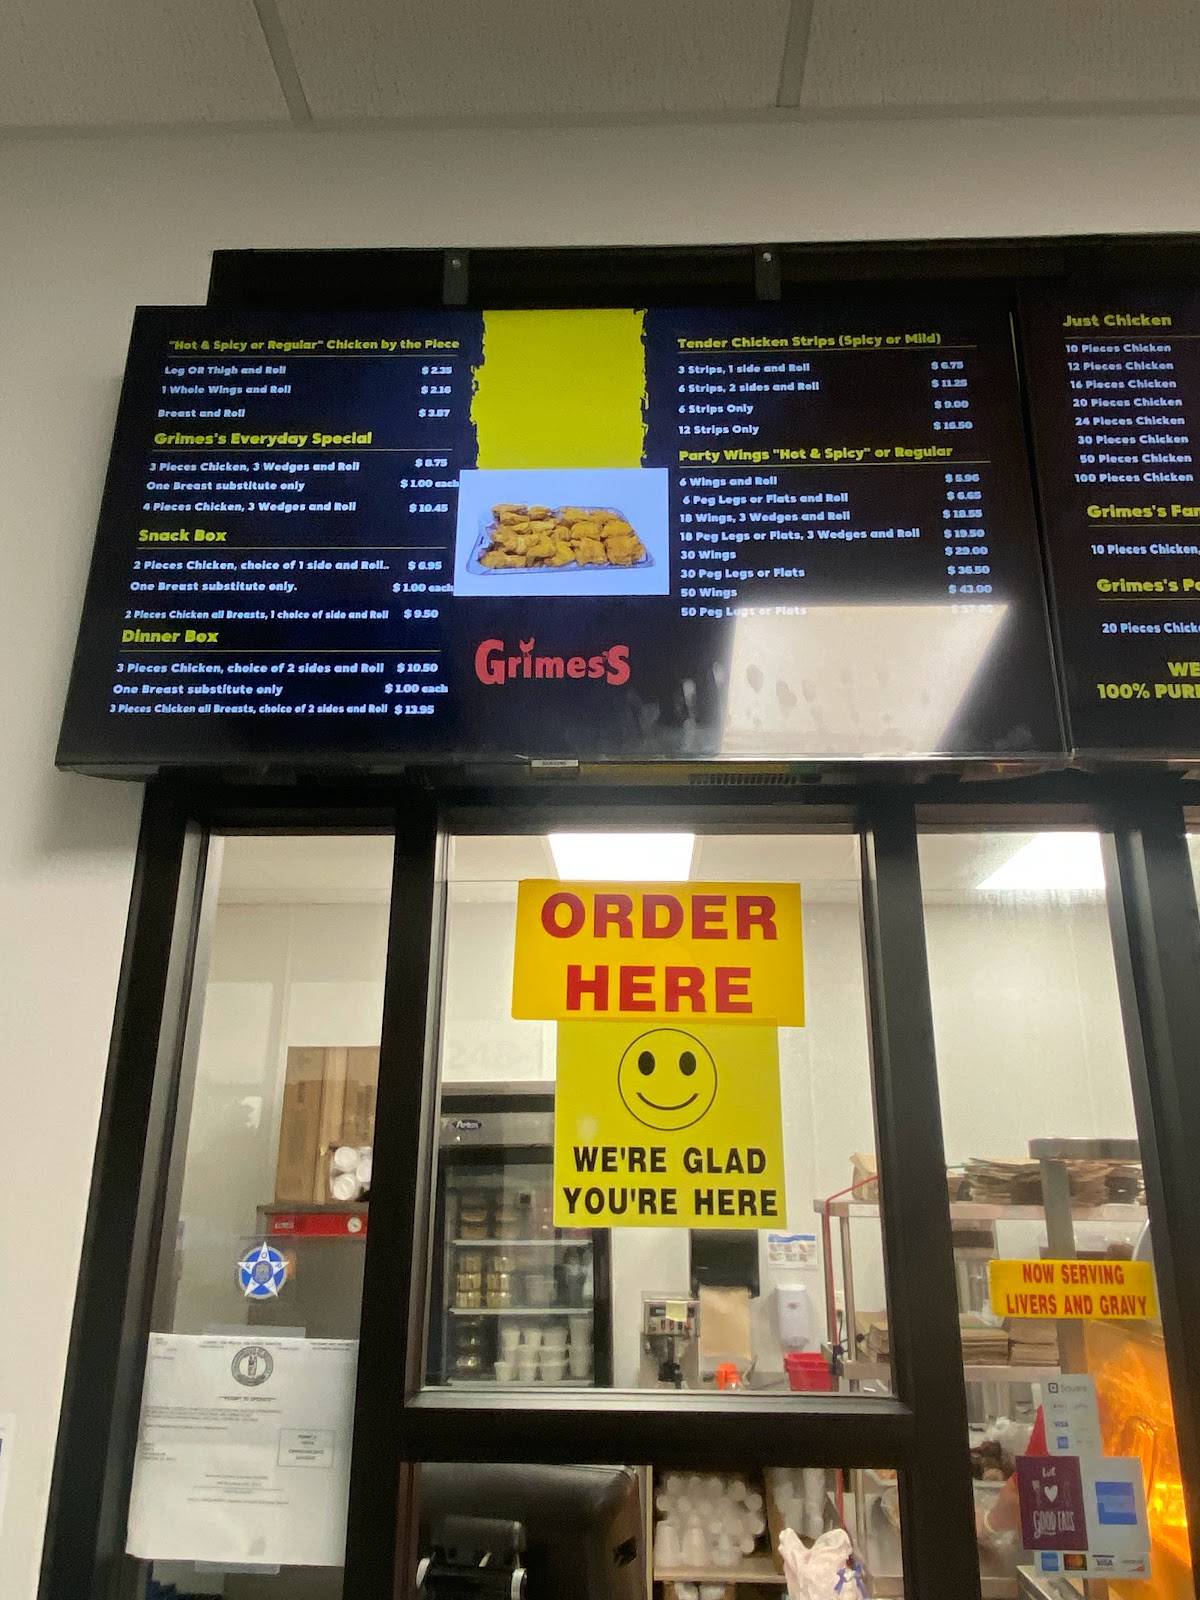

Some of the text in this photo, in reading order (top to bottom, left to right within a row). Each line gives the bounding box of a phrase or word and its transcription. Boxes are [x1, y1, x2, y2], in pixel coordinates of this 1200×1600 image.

[1062, 313, 1172, 327] Just Chicken
[200, 340, 210, 350] &
[213, 339, 248, 352] Spicy
[326, 339, 378, 349] Chicken
[381, 339, 398, 352] by
[400, 339, 422, 349] the
[425, 338, 460, 352] Piece
[677, 333, 941, 349] Tender Chicken Strips (Spicy or Mild)
[1066, 343, 1171, 353] 10 Pieces Chicken
[164, 365, 286, 377] Leg OR Thigh and Roll
[678, 363, 810, 376] 3 Strips, 1 side and Roll
[1067, 361, 1174, 371] 12 Pieces Chicken
[162, 384, 292, 396] 1 Whole Wings and Roll
[1070, 379, 1177, 389] 16 Pieces Chicken
[1073, 397, 1183, 408] 20 Pieces Chicken
[158, 408, 246, 418] Breast and Roll
[678, 403, 754, 415] 6 Strips Only
[1075, 416, 1185, 426] 24 Pieces Chicken
[678, 424, 759, 436] 12 Strips Only
[154, 431, 372, 448] Grimes's Everyday Special
[1078, 434, 1189, 445] 30 Pieces Chicken
[678, 450, 720, 464] Party
[723, 448, 770, 463] Wings
[810, 448, 821, 459] &
[874, 449, 891, 458] or
[894, 446, 953, 460] Regular
[1080, 453, 1192, 464] 50 Pieces Chicken
[149, 461, 360, 474] 3 Pieces Chicken, 3 Wedges and Roll
[679, 476, 777, 488] 6 Wings and Roll
[1074, 472, 1194, 483] 100 Pieces Chicken
[146, 480, 305, 492] One Breast substitute only
[682, 492, 848, 507] 6 Peg Legs or Flats and Roll
[409, 503, 418, 513] $
[1087, 504, 1167, 518] Grimes's
[138, 528, 227, 542] Snack Box
[944, 528, 952, 539] $
[1091, 544, 1105, 555] 10
[1107, 544, 1147, 555] Pieces
[133, 560, 141, 570] 2
[144, 560, 183, 570] Pieces
[186, 560, 237, 571] Chicken,
[240, 560, 280, 570] choice
[282, 560, 296, 570] of
[298, 560, 304, 570] 1
[306, 560, 333, 570] side
[334, 560, 359, 570] and
[408, 560, 416, 571] $
[1096, 578, 1179, 592] Grimes's
[403, 608, 412, 620] $
[1102, 622, 1200, 634] 20 Pieces Chick
[122, 628, 219, 643] Dinner Box
[396, 662, 406, 674] $
[1097, 683, 1150, 699] 100%
[541, 892, 778, 940] ORDER
[566, 964, 753, 1013] HERE
[573, 1146, 767, 1175] WE'RE GLAD
[563, 1187, 779, 1217] YOU'RE HERE
[1022, 1263, 1125, 1285] NOW SERVING
[1006, 1294, 1147, 1316] LIVERS AND GRAVY
